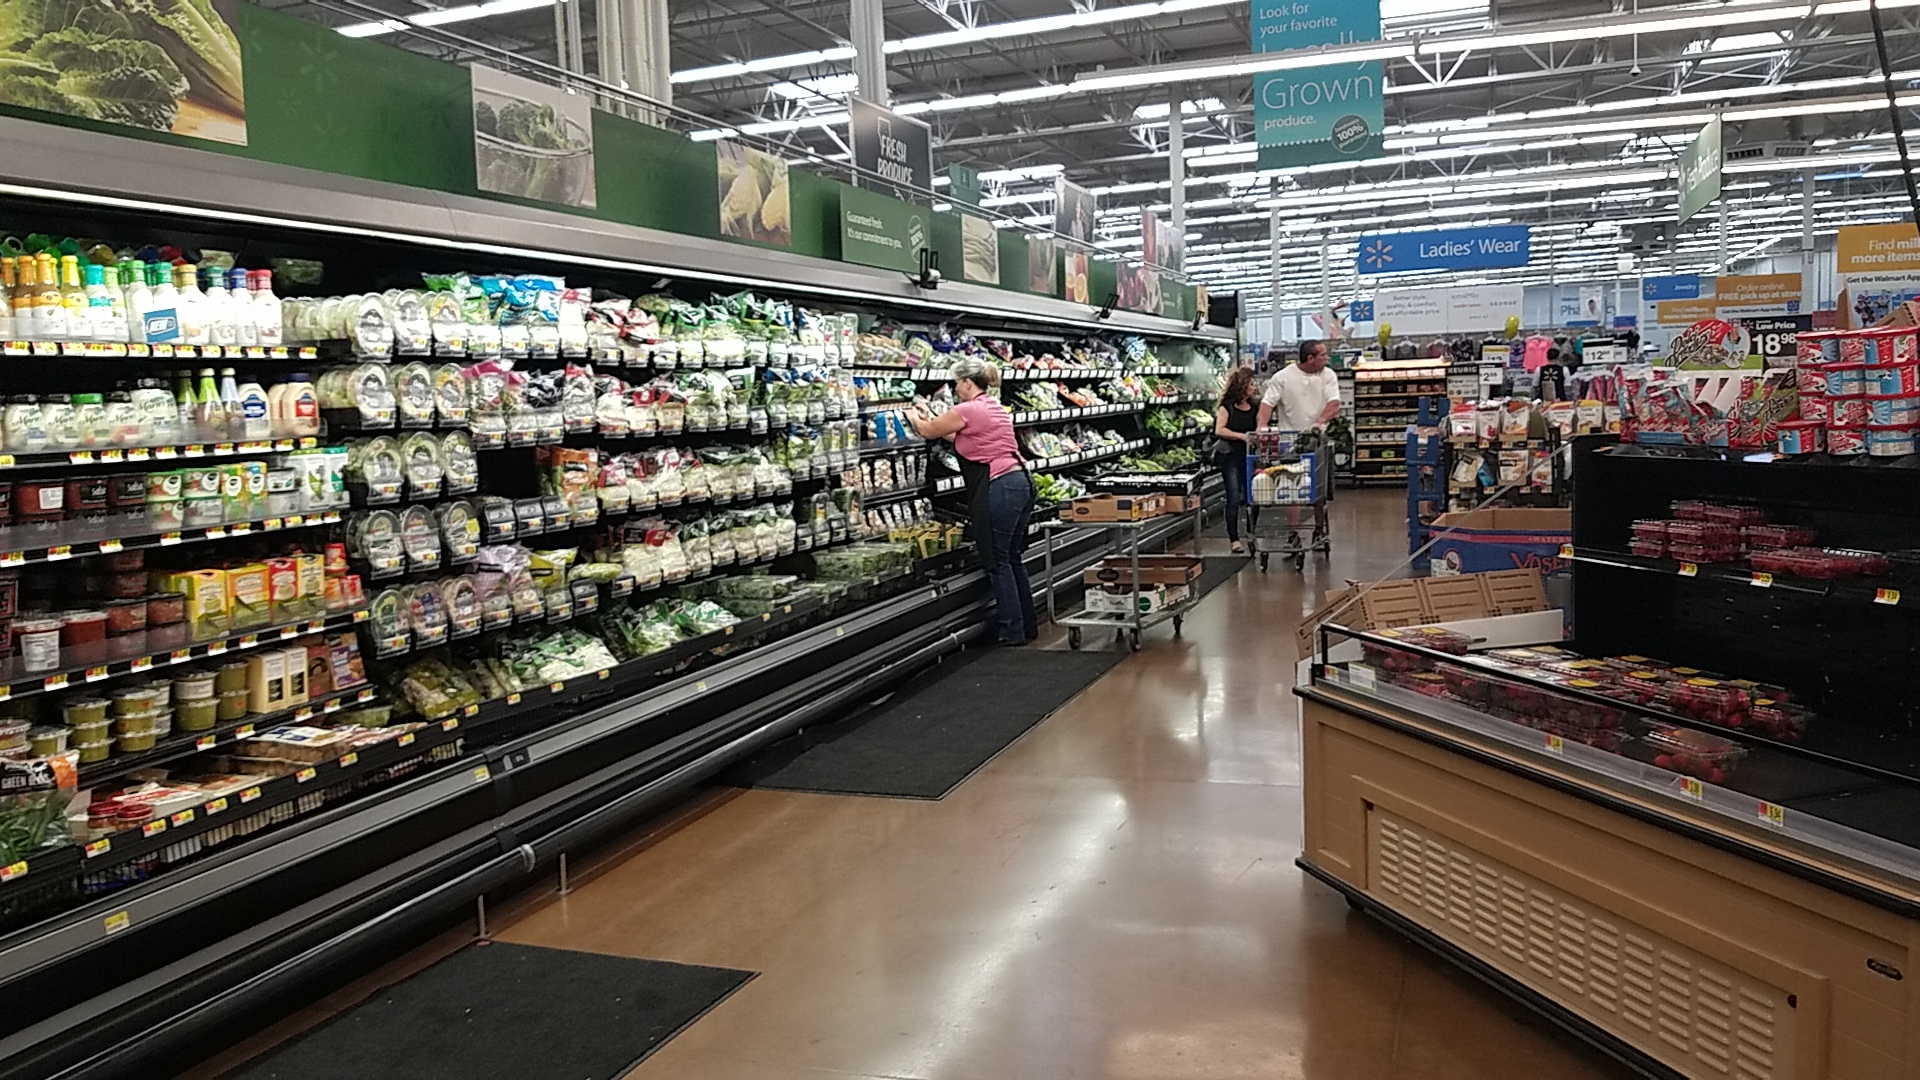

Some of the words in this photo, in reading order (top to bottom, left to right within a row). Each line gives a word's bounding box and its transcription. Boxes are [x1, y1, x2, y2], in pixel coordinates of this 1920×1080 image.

[1260, 6, 1289, 19] Look
[1293, 3, 1309, 15] for
[1260, 24, 1288, 38] your
[1290, 16, 1338, 31] favorite
[1262, 75, 1374, 109] Grown
[1264, 114, 1317, 131] produce.
[1337, 124, 1365, 141] 100%
[880, 134, 907, 163] FRESH
[1419, 239, 1475, 258] Ladies'
[1478, 238, 1521, 254] Wear
[1869, 239, 1895, 251] Find
[1851, 255, 1886, 264] more
[1887, 251, 1920, 262] items
[1847, 276, 1860, 284] Get
[1874, 274, 1905, 283] Walmart
[1755, 323, 1773, 331] Low
[1774, 321, 1797, 330] Price
[1447, 366, 1478, 374] KEURIG
